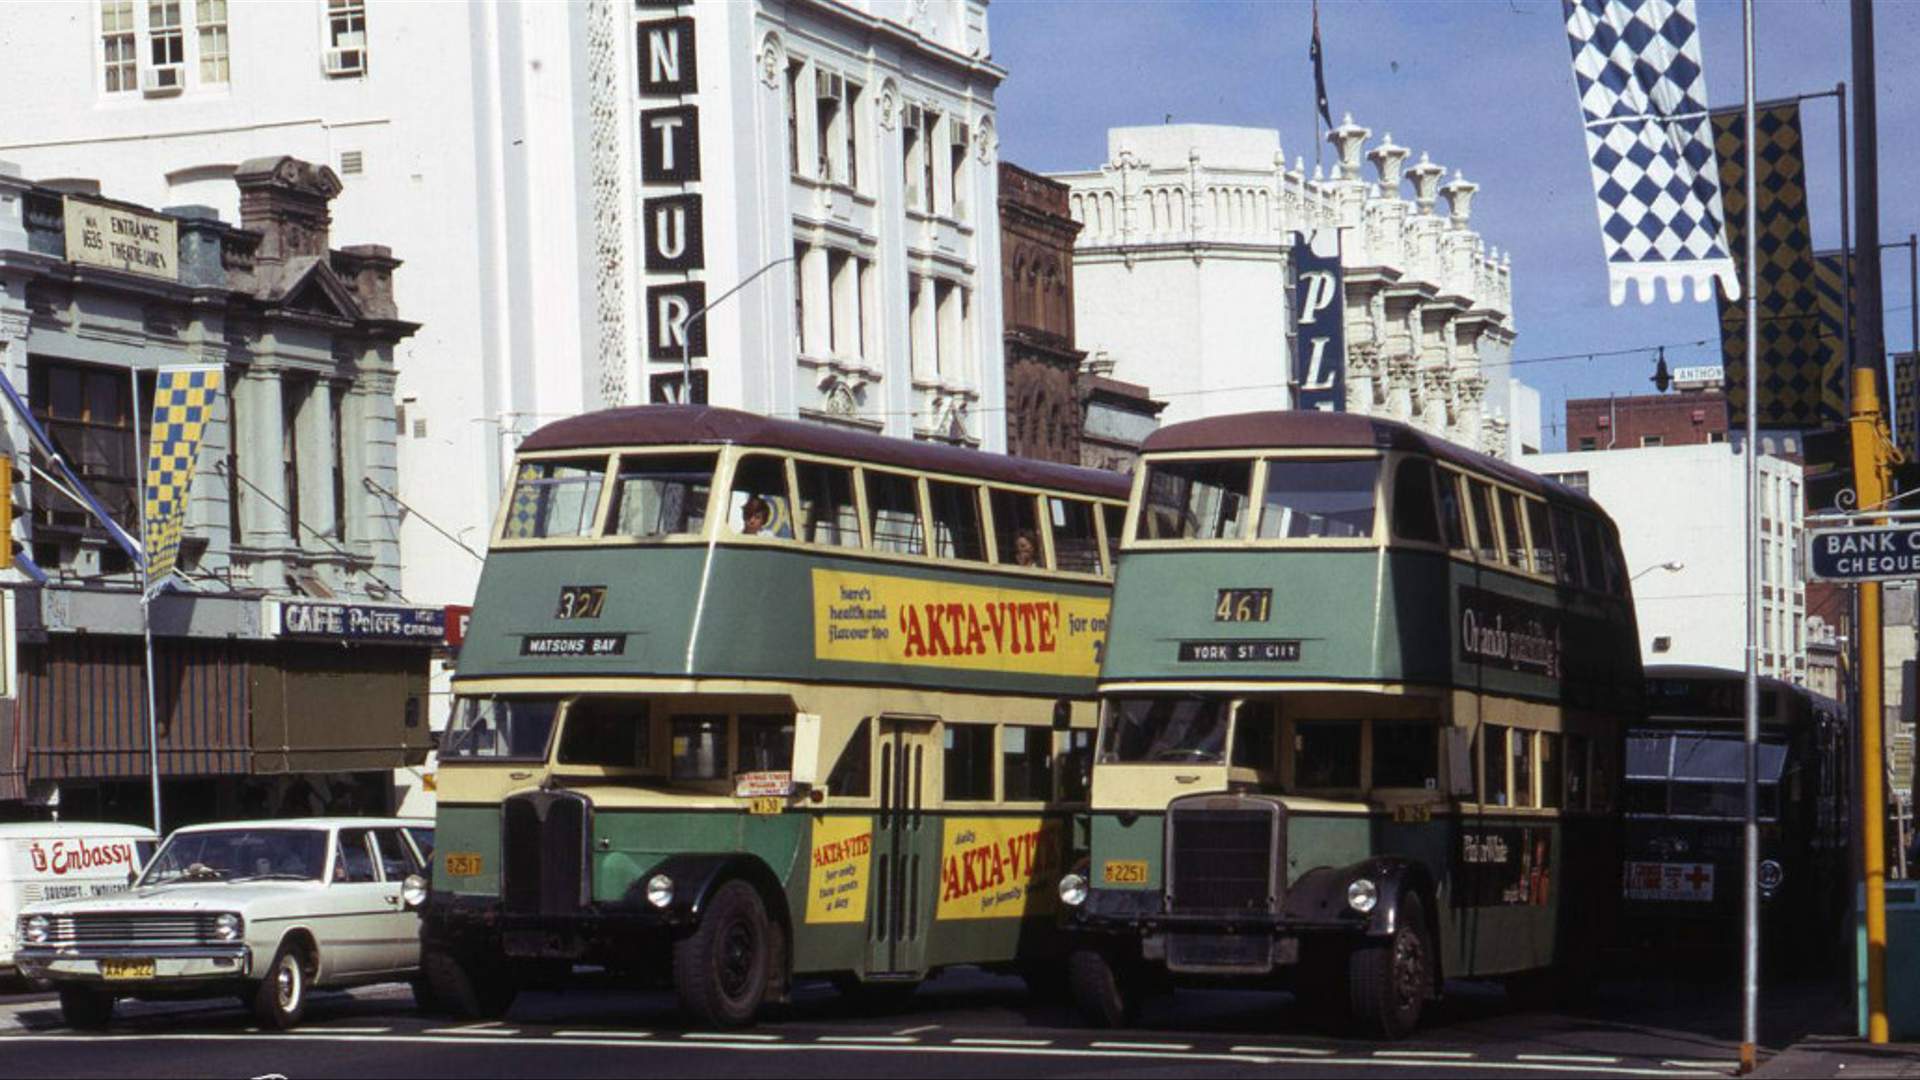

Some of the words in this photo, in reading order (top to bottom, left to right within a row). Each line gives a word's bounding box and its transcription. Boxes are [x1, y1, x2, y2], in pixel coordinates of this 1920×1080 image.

[111, 216, 160, 244] ENTRANCE
[1298, 271, 1337, 411] PL
[1827, 532, 1896, 554] BANK
[1837, 555, 1920, 573] CHEQUE
[560, 588, 608, 619] 327
[1217, 591, 1268, 621] 461
[286, 605, 344, 633] CAFE
[350, 607, 400, 636] Peters
[530, 639, 586, 652] WATSONS
[592, 639, 617, 652] BAY
[1193, 645, 1228, 659] YORK
[1238, 645, 1256, 659] ST
[1266, 645, 1295, 658] CITY
[52, 838, 135, 875] Embassy
[1115, 864, 1145, 881] 2251
